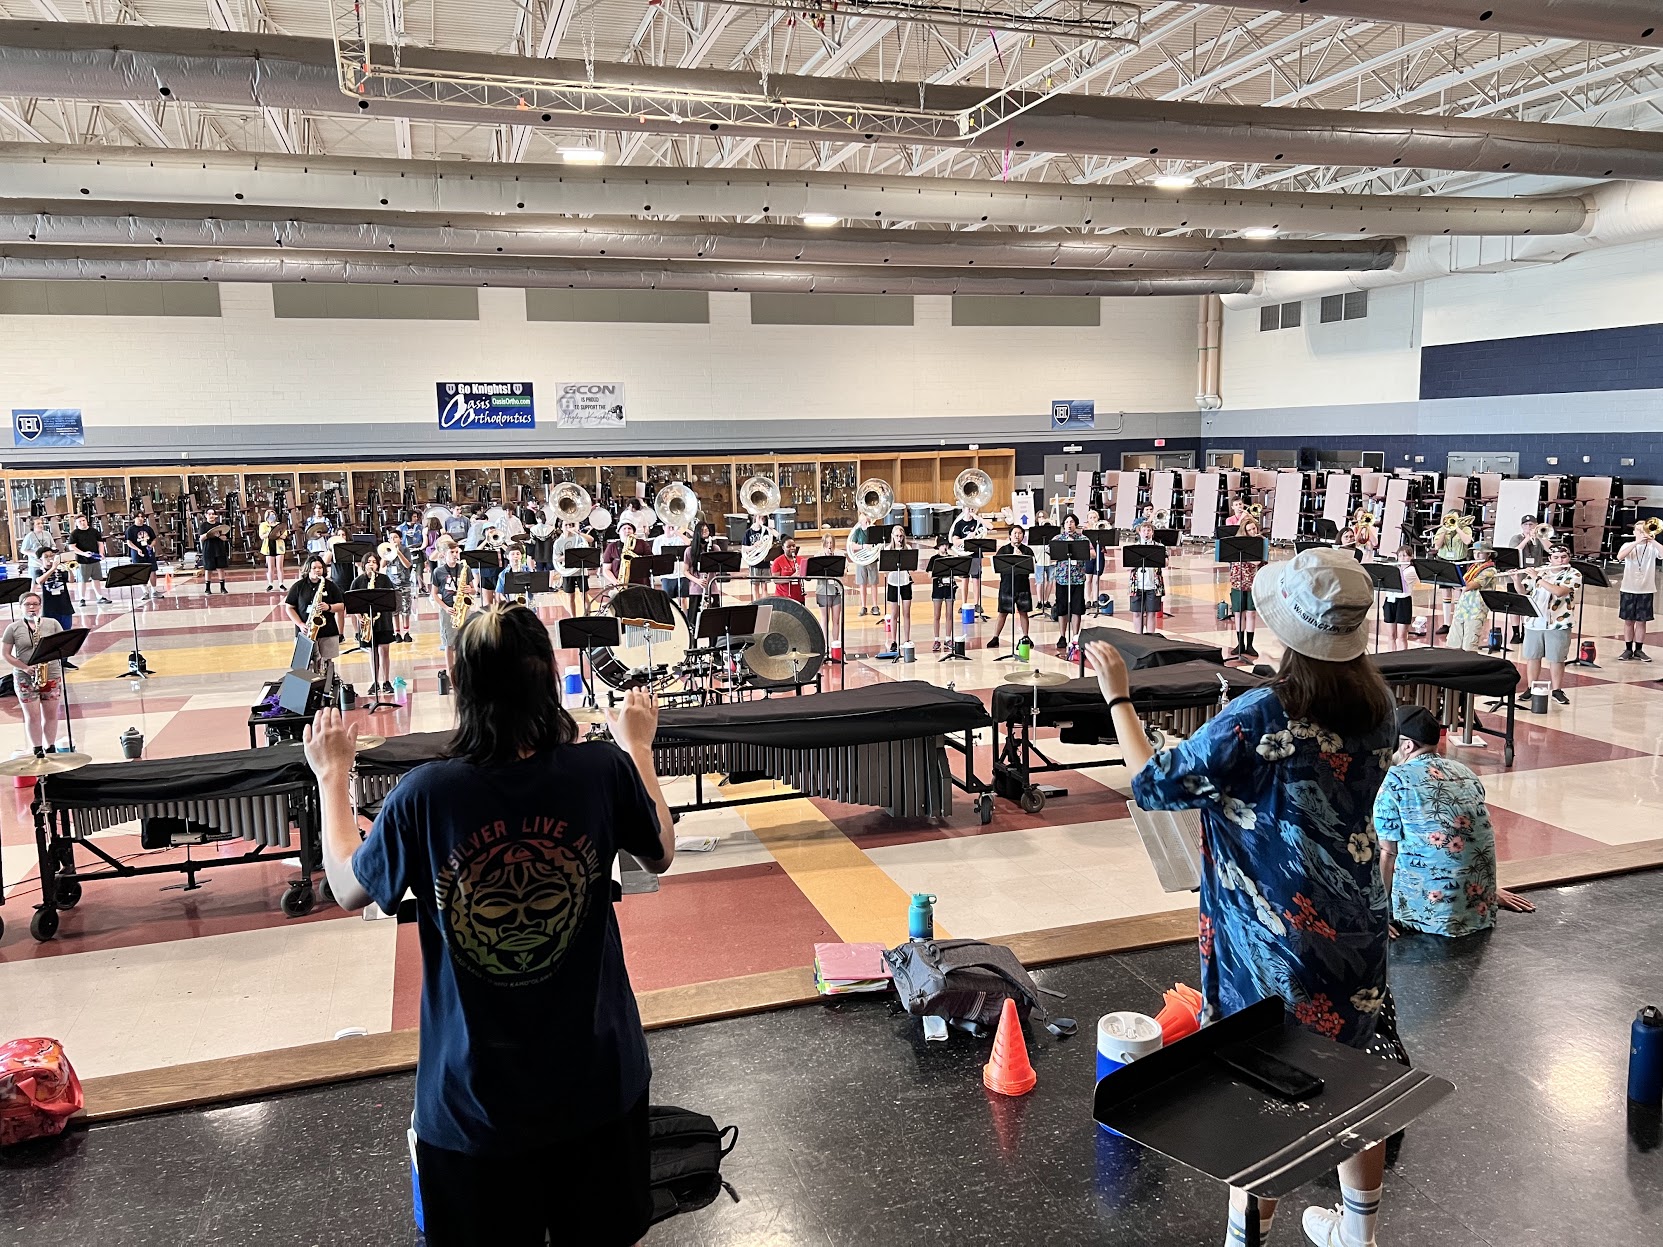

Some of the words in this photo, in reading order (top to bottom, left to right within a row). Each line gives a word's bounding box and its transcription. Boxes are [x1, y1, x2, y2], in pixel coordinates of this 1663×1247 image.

[458, 383, 471, 394] Go
[472, 383, 511, 395] Knights!
[563, 385, 615, 394] GCON
[441, 393, 490, 427] Oasis
[461, 408, 531, 427] Orthodontics
[19, 417, 39, 432] H
[1294, 603, 1341, 633] WASHINGTON
[522, 816, 569, 838] LIVE
[573, 834, 602, 885] ALOHA
